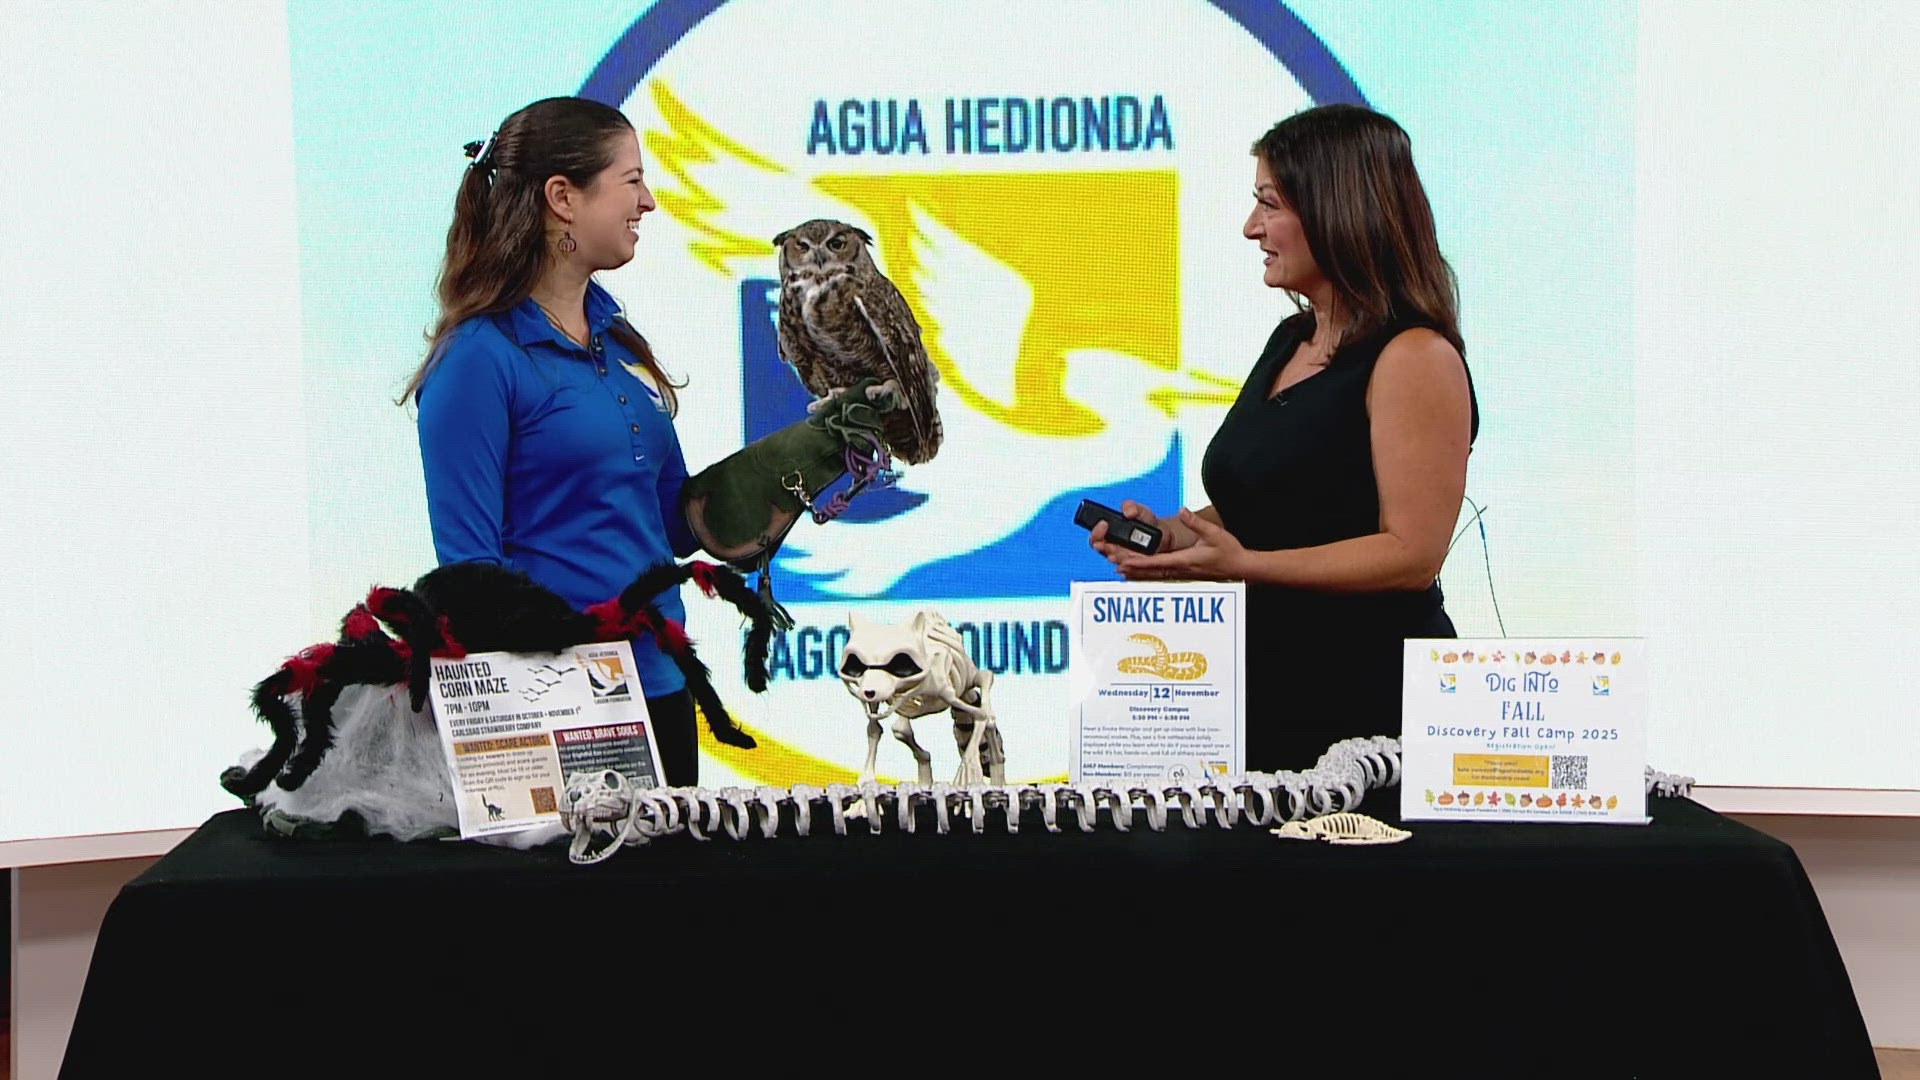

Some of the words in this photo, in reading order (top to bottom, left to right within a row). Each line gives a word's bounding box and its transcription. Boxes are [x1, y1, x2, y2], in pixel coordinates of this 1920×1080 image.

[807, 98, 930, 155] AGUA
[945, 95, 1175, 154] HEDIONDA
[1093, 597, 1164, 623] SNAKE
[1171, 597, 1225, 623] TALK
[435, 661, 491, 681] HAUNTED
[440, 680, 473, 698] CORN
[474, 677, 509, 695] MAZE
[1098, 688, 1148, 698] Wednesday
[1153, 687, 1170, 698] 12
[1175, 688, 1220, 697] November
[444, 703, 463, 715] 7PM
[468, 700, 490, 712] 10PM
[1129, 706, 1161, 714] Discovery
[1163, 706, 1189, 714] Campus
[1502, 701, 1545, 721] FALL
[449, 717, 466, 727] EVERY
[466, 716, 484, 725] FRIDAY
[489, 713, 515, 723] SATURDAY
[522, 710, 543, 719] OCTOBER
[548, 708, 574, 717] NOVEMBER
[451, 727, 480, 737] CARLSBAD
[480, 723, 515, 734] STRAWBERRY
[516, 721, 541, 730] COMPANY
[562, 729, 594, 742] WANTED:
[594, 726, 616, 740] BRAVE
[617, 724, 638, 737] SOULS
[1427, 725, 1496, 740] Discovery
[1503, 726, 1530, 738] Fall
[1582, 729, 1618, 740] 2025
